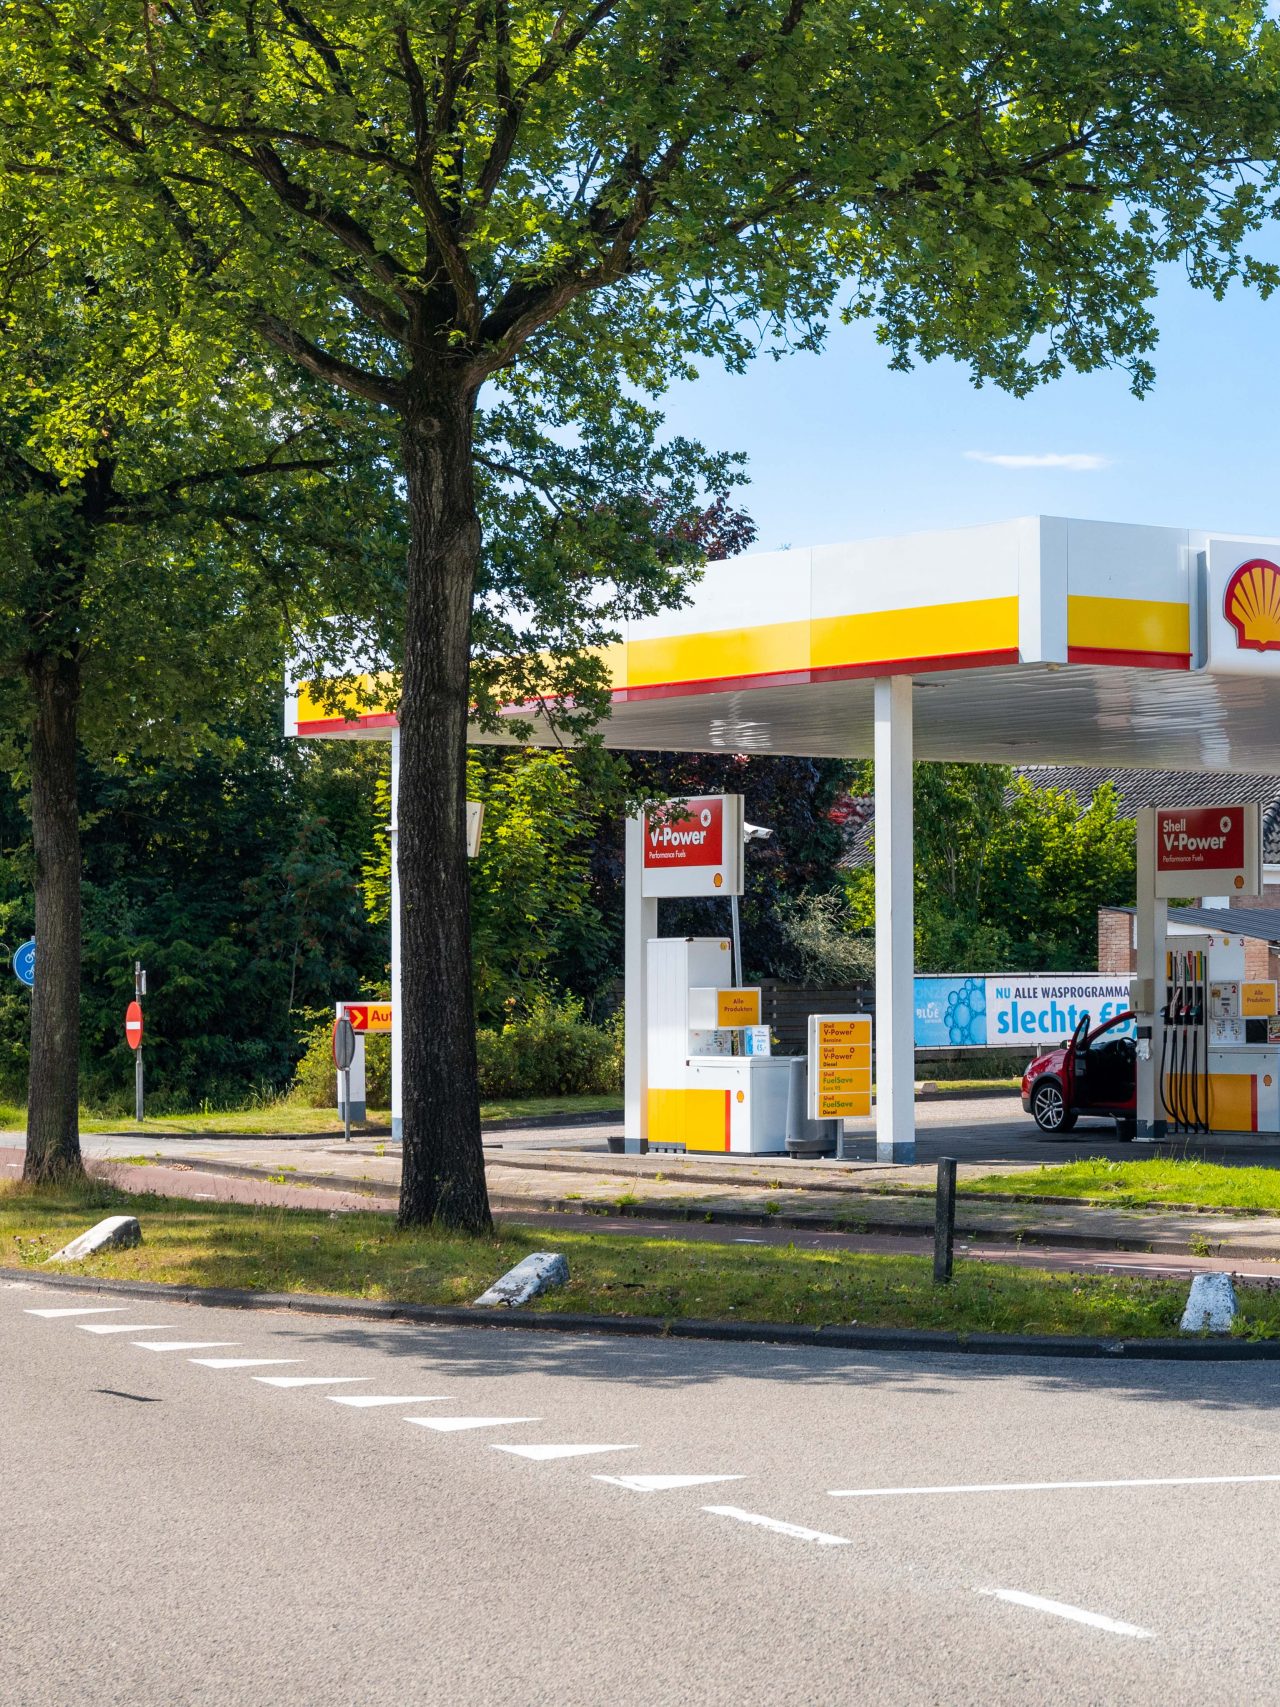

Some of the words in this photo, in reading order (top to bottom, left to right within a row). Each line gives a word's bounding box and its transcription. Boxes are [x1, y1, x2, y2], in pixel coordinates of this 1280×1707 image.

[1162, 818, 1186, 833] Shell
[650, 827, 707, 847] V-Power
[1163, 833, 1227, 852] V-Power
[648, 850, 675, 859] Performance
[675, 849, 686, 858] Fuels
[1162, 855, 1191, 863] Performance
[1191, 853, 1204, 862] Fuels
[1209, 938, 1215, 947] 2
[1239, 938, 1245, 947] 3
[995, 987, 1011, 999] NU
[1014, 987, 1038, 999] ALLE
[1231, 985, 1237, 994] 2
[823, 1076, 853, 1084] FuelSave
